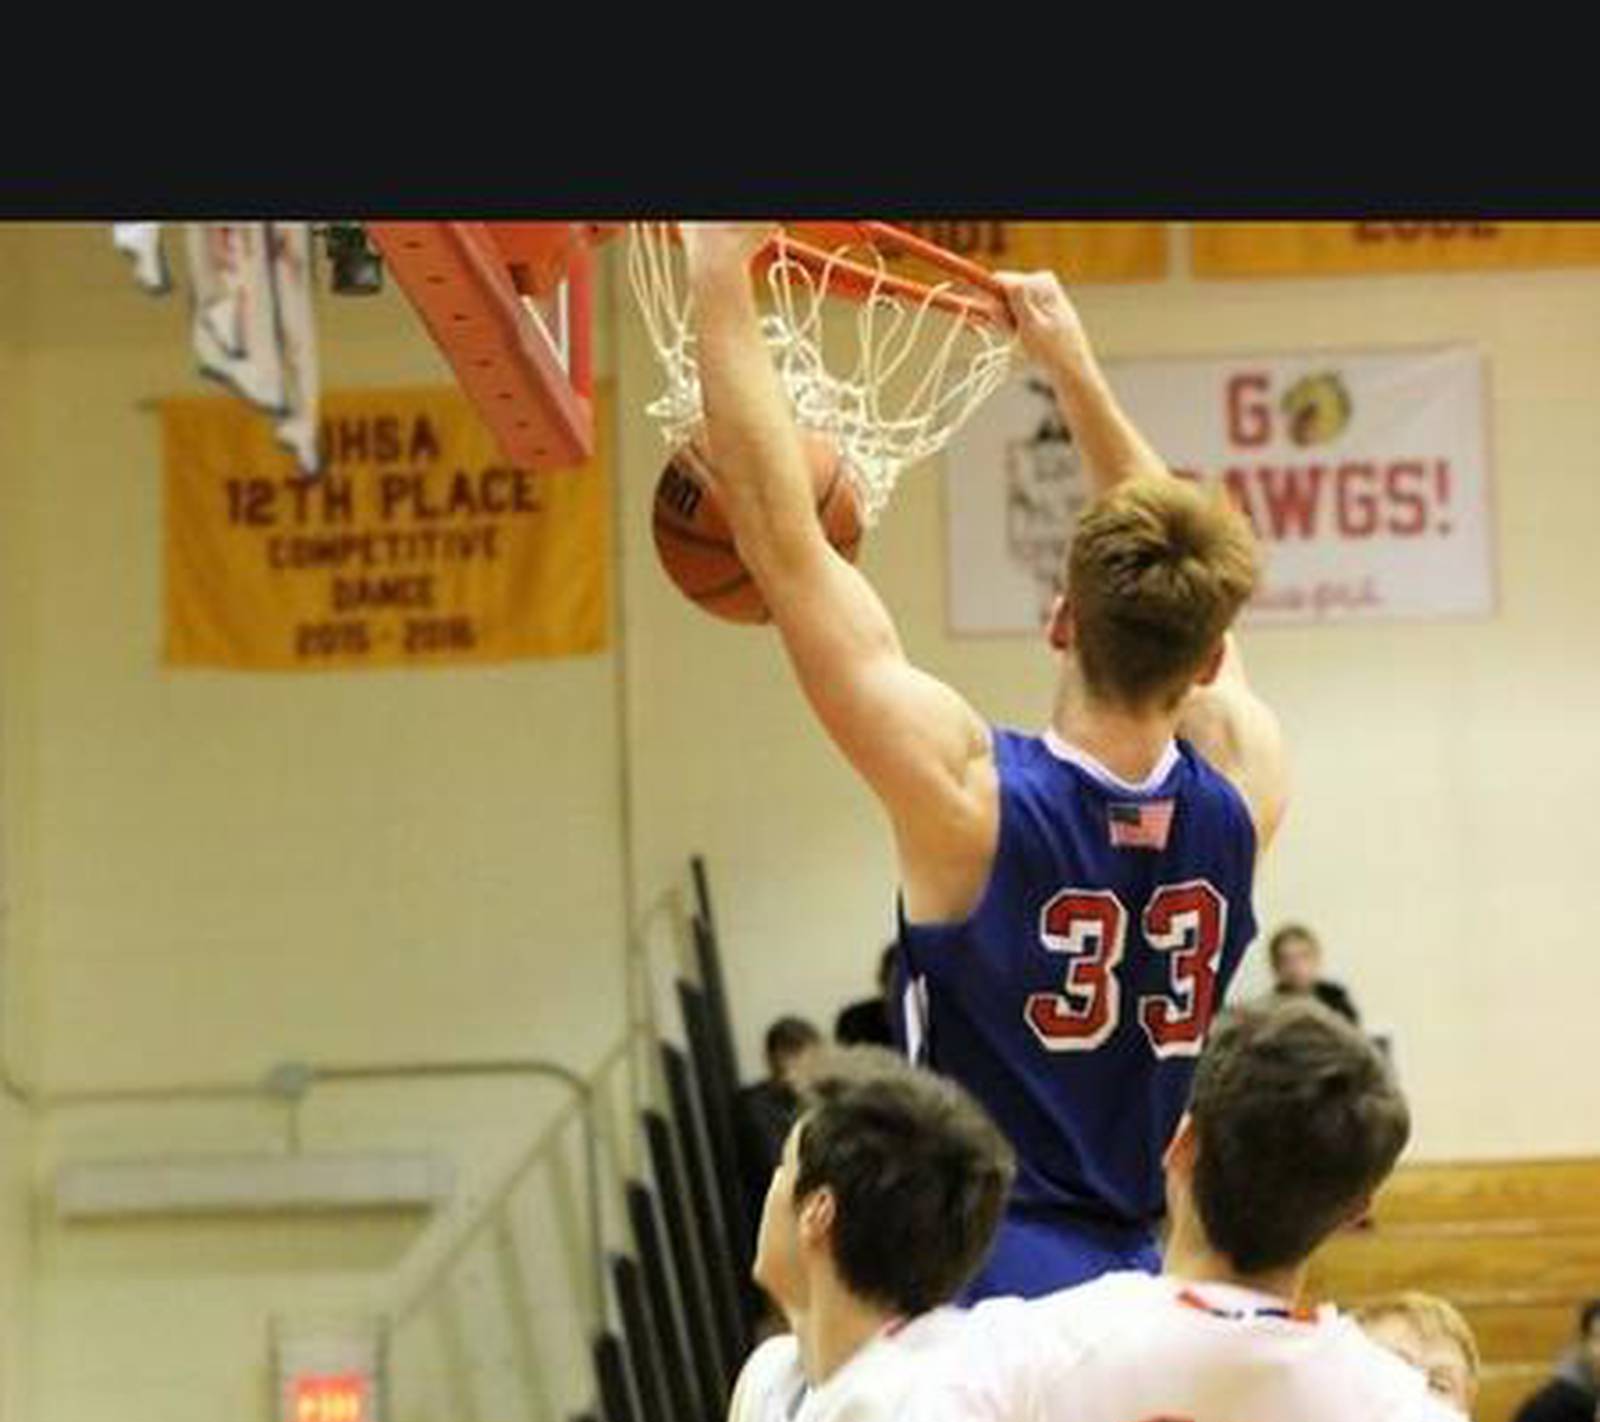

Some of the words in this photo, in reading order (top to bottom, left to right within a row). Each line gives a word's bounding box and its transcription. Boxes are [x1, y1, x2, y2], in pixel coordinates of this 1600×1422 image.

[227, 474, 353, 527] 12TH
[381, 465, 541, 519] PLACE
[267, 524, 501, 571] COMPETITIVE
[332, 574, 434, 613] DANCE
[1023, 877, 1228, 1060] 33
